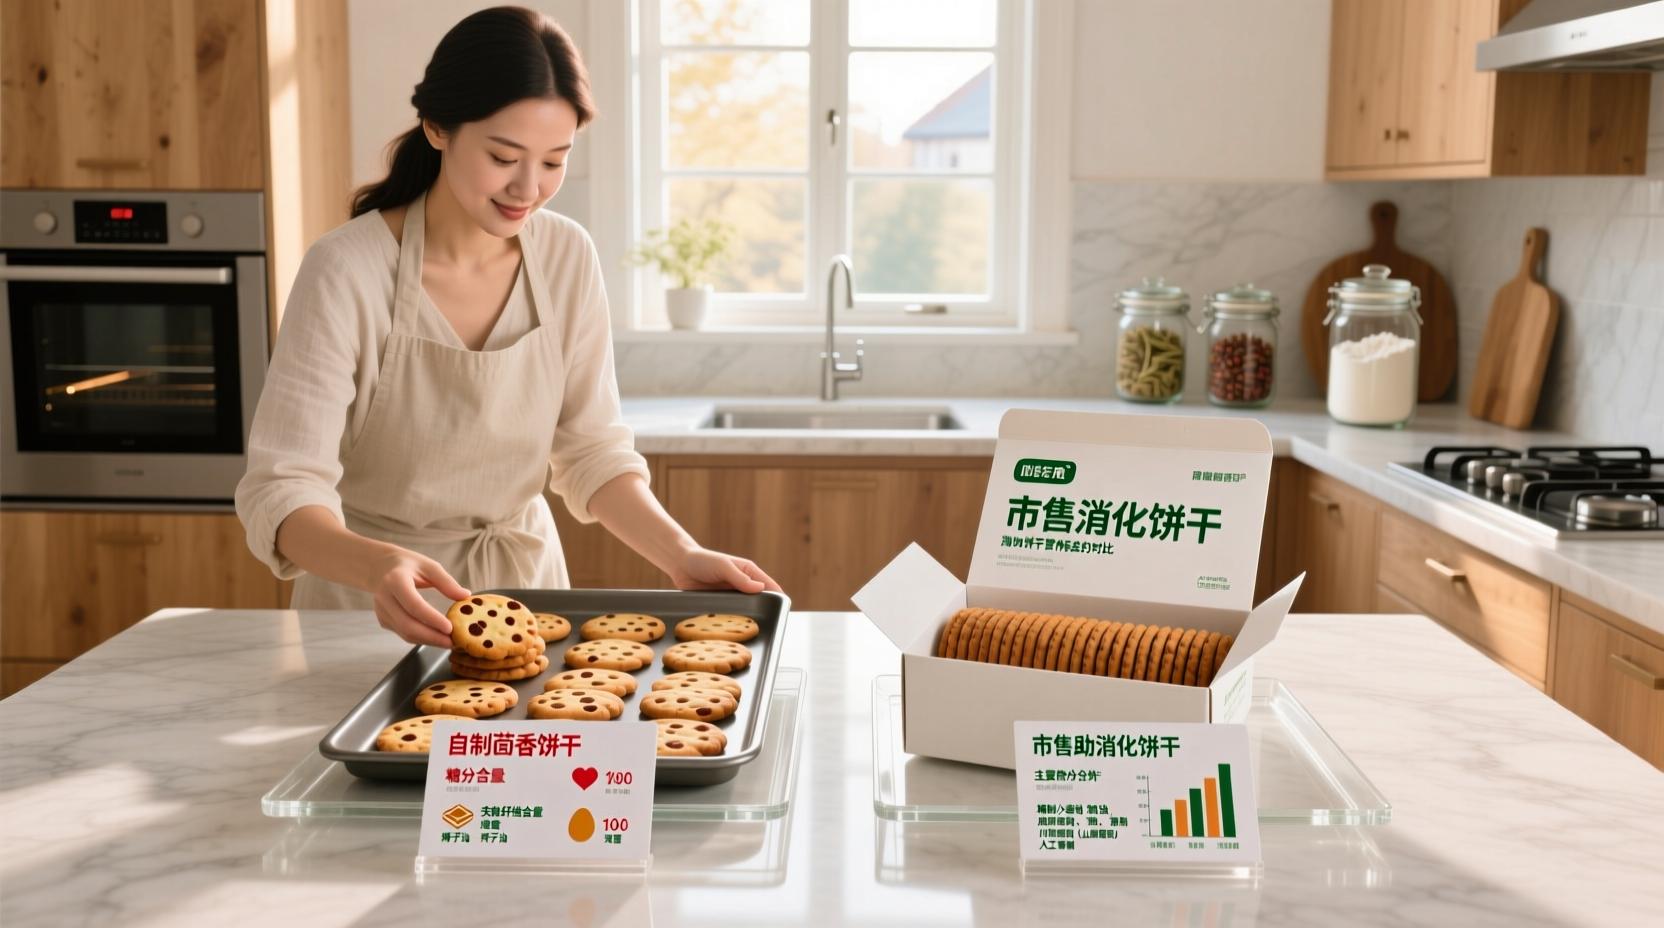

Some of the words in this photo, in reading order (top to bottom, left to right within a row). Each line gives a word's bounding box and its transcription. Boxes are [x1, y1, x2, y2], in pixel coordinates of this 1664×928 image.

[1006, 495, 1222, 544] 市售消化饼干
[448, 731, 582, 757] 自制茴香饼干
[1032, 733, 1181, 758] 市售助消化饼干
[602, 818, 629, 832] 100
